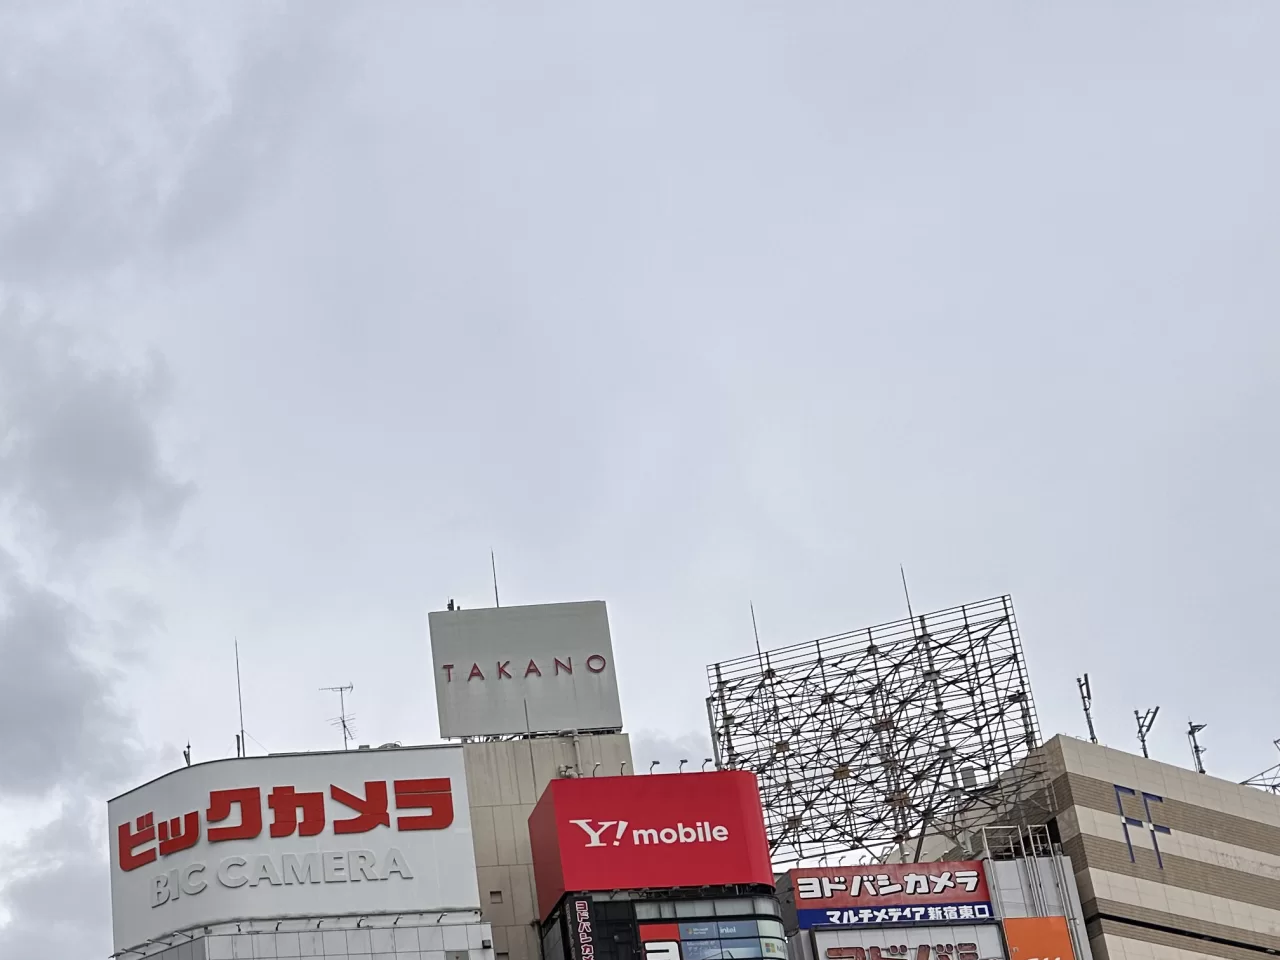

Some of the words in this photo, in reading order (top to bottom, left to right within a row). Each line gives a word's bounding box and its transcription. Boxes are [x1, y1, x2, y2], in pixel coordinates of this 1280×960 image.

[443, 655, 607, 683] TAKANO
[118, 777, 455, 872] ビックカメラ
[150, 862, 208, 909] BIC
[217, 847, 414, 888] CAMERA
[797, 870, 979, 899] ヨドバシカメラ
[720, 926, 737, 934] intel
